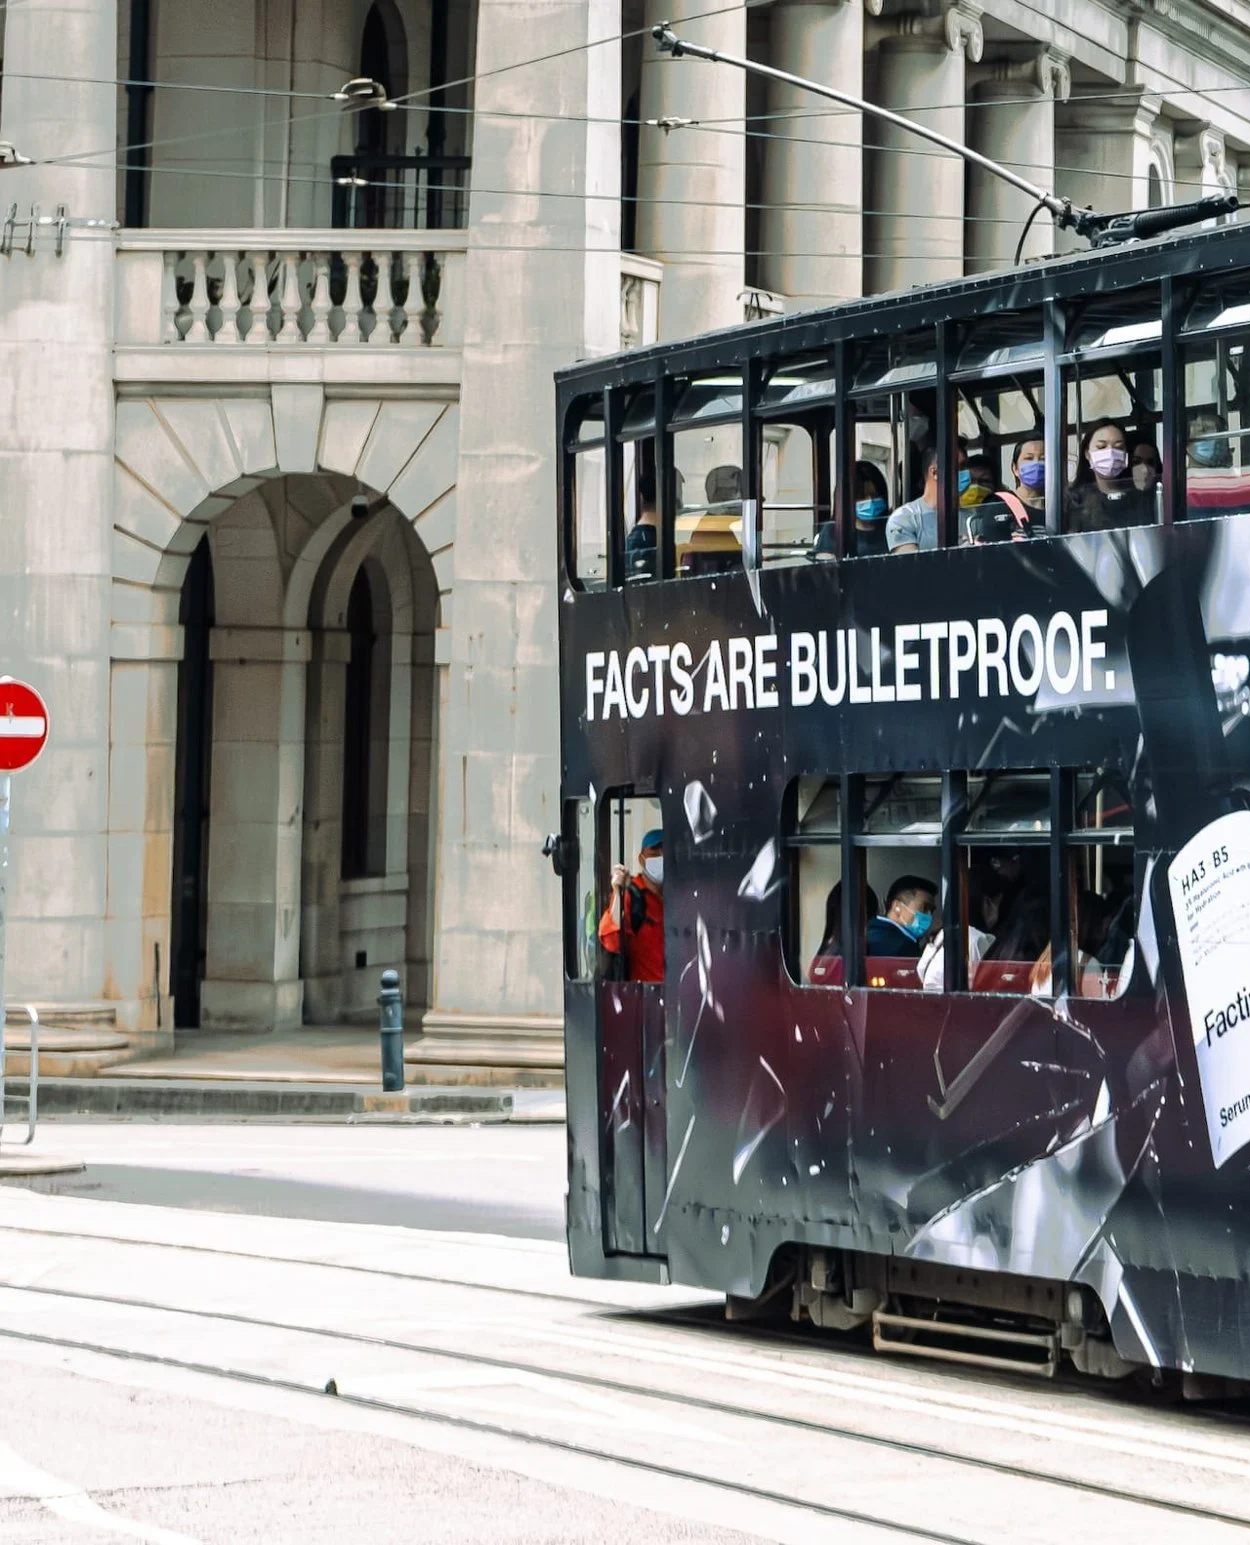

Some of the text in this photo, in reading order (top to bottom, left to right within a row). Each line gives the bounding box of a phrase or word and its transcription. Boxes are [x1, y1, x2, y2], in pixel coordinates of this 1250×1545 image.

[585, 609, 1115, 721] FACTS ARE BULLETPROOF.
[1181, 845, 1229, 896] HA3 B5
